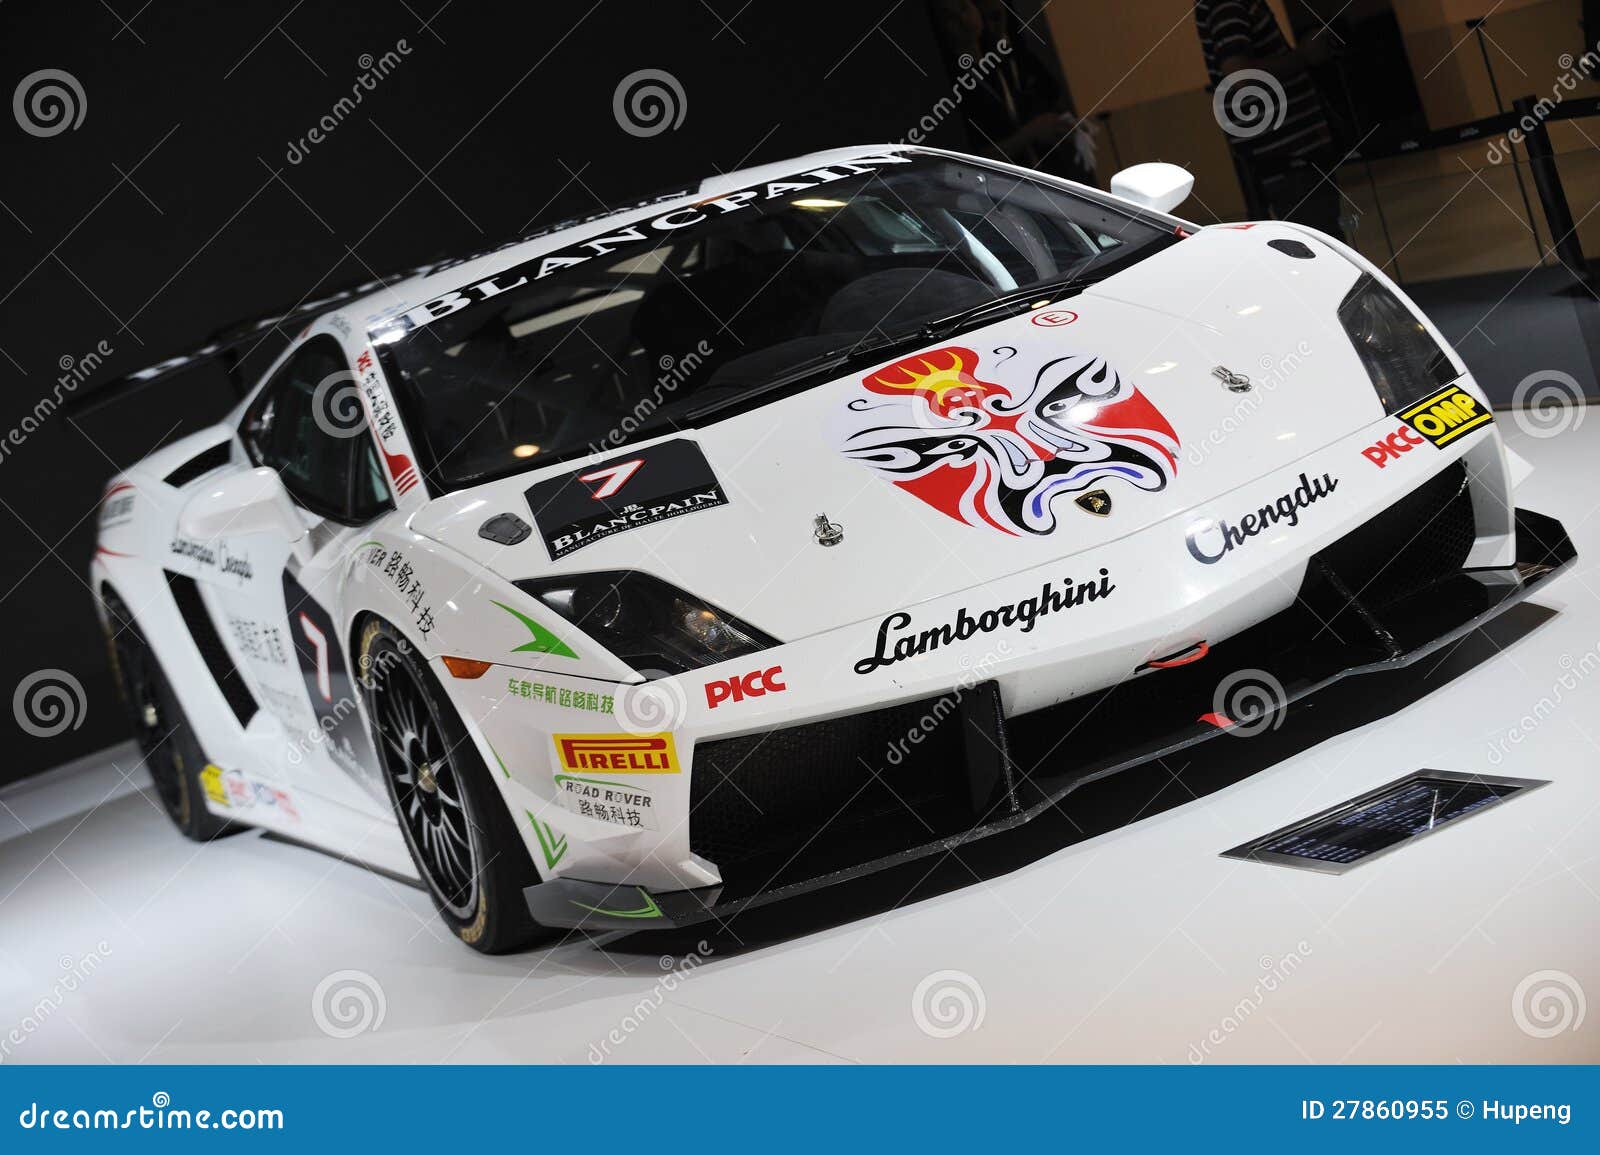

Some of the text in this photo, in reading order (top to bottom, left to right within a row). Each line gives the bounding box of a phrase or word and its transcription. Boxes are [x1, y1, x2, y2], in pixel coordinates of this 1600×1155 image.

[411, 151, 914, 330] BLANCPAIN
[1413, 393, 1478, 437] OMP
[1361, 425, 1426, 469] PICC
[578, 458, 647, 501] 7
[551, 490, 718, 551] BLANCPAIN
[555, 500, 723, 558] MANUFACTURE DE HAUTE HORLOGERIE
[1185, 472, 1339, 565] Chengdu
[384, 551, 435, 641] 路畅科技
[854, 568, 1116, 675] Lamborghini
[299, 611, 332, 703] 7
[704, 665, 787, 710] PICC
[561, 738, 671, 769] PIRELLI
[566, 781, 652, 808] ROAD ROVER
[577, 799, 644, 828] 路畅科技
